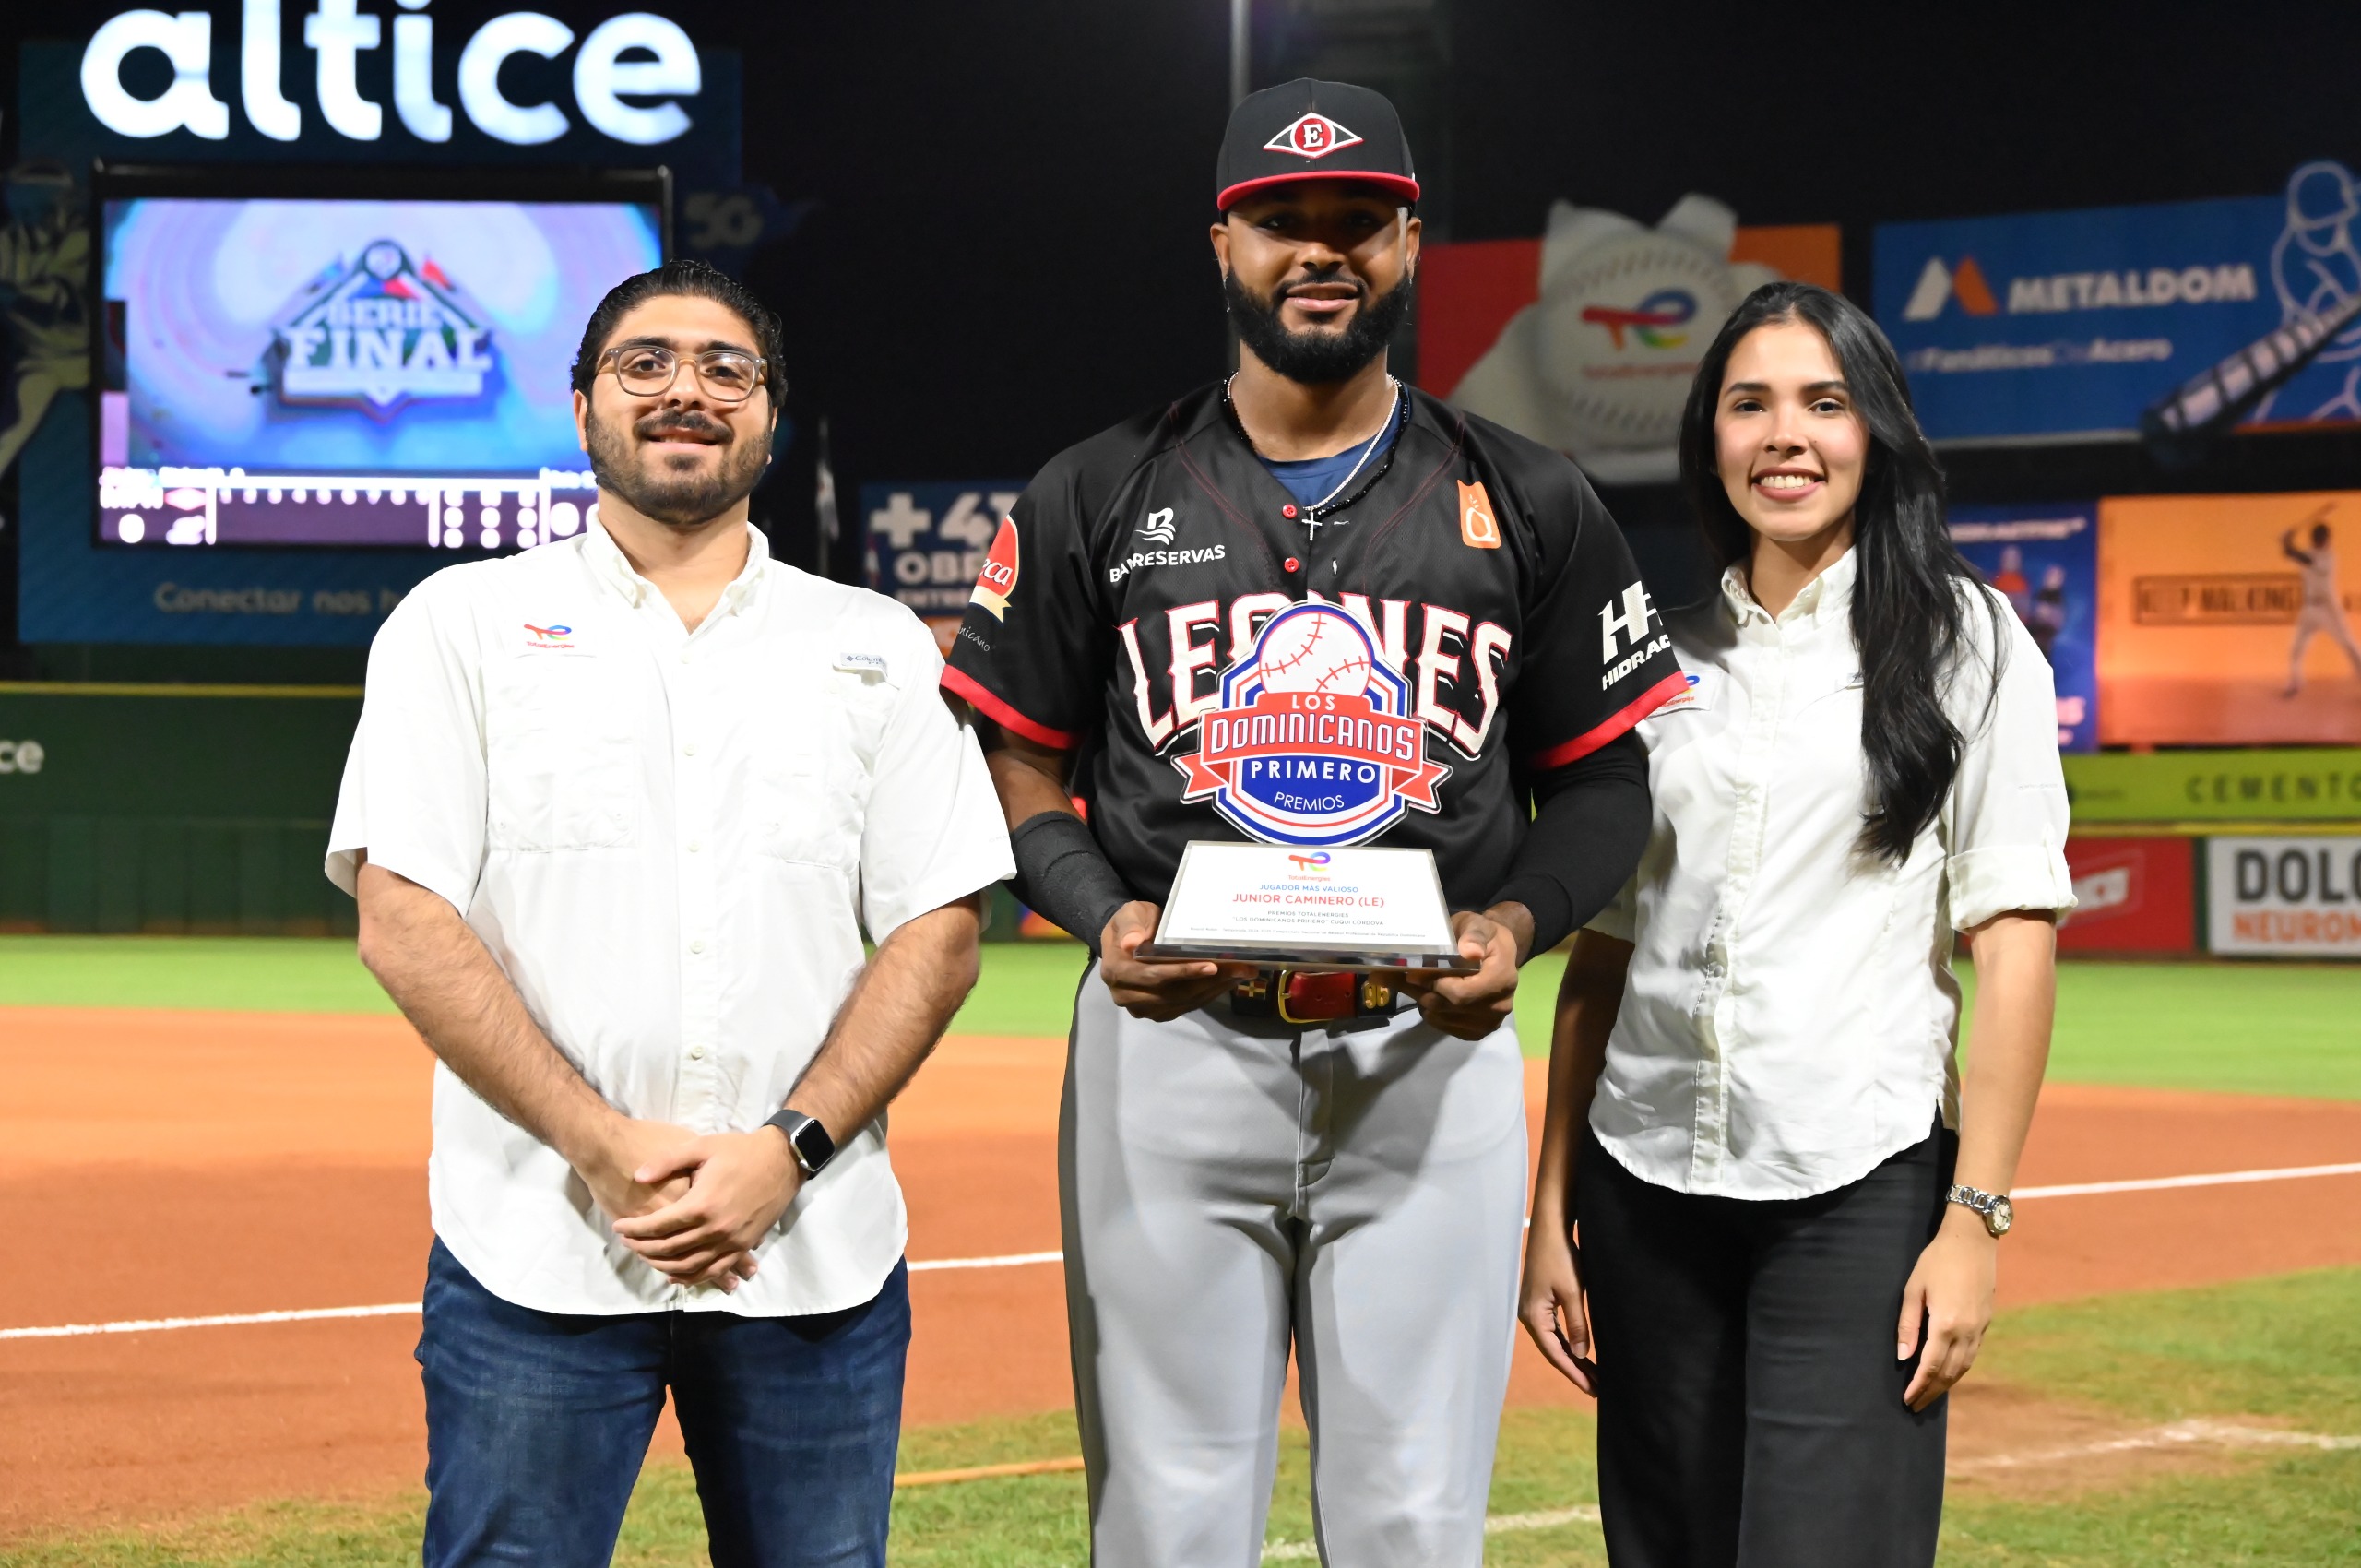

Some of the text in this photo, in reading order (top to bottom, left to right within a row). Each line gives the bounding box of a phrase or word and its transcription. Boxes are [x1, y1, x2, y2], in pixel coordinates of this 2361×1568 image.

[81, 0, 701, 145] altice
[1303, 124, 1323, 148] E
[2008, 263, 2257, 314] METALDOM
[287, 328, 492, 369] FINAL
[153, 581, 303, 614] Conectar
[1292, 695, 1335, 711] LOS
[1210, 713, 1415, 761] DOMINICANOS
[1251, 760, 1376, 783] PRIMERO
[1274, 791, 1345, 811] PREMIOS
[2236, 848, 2361, 903] DOL
[1232, 893, 1384, 908] JUNIOR CAMINERO (LE)
